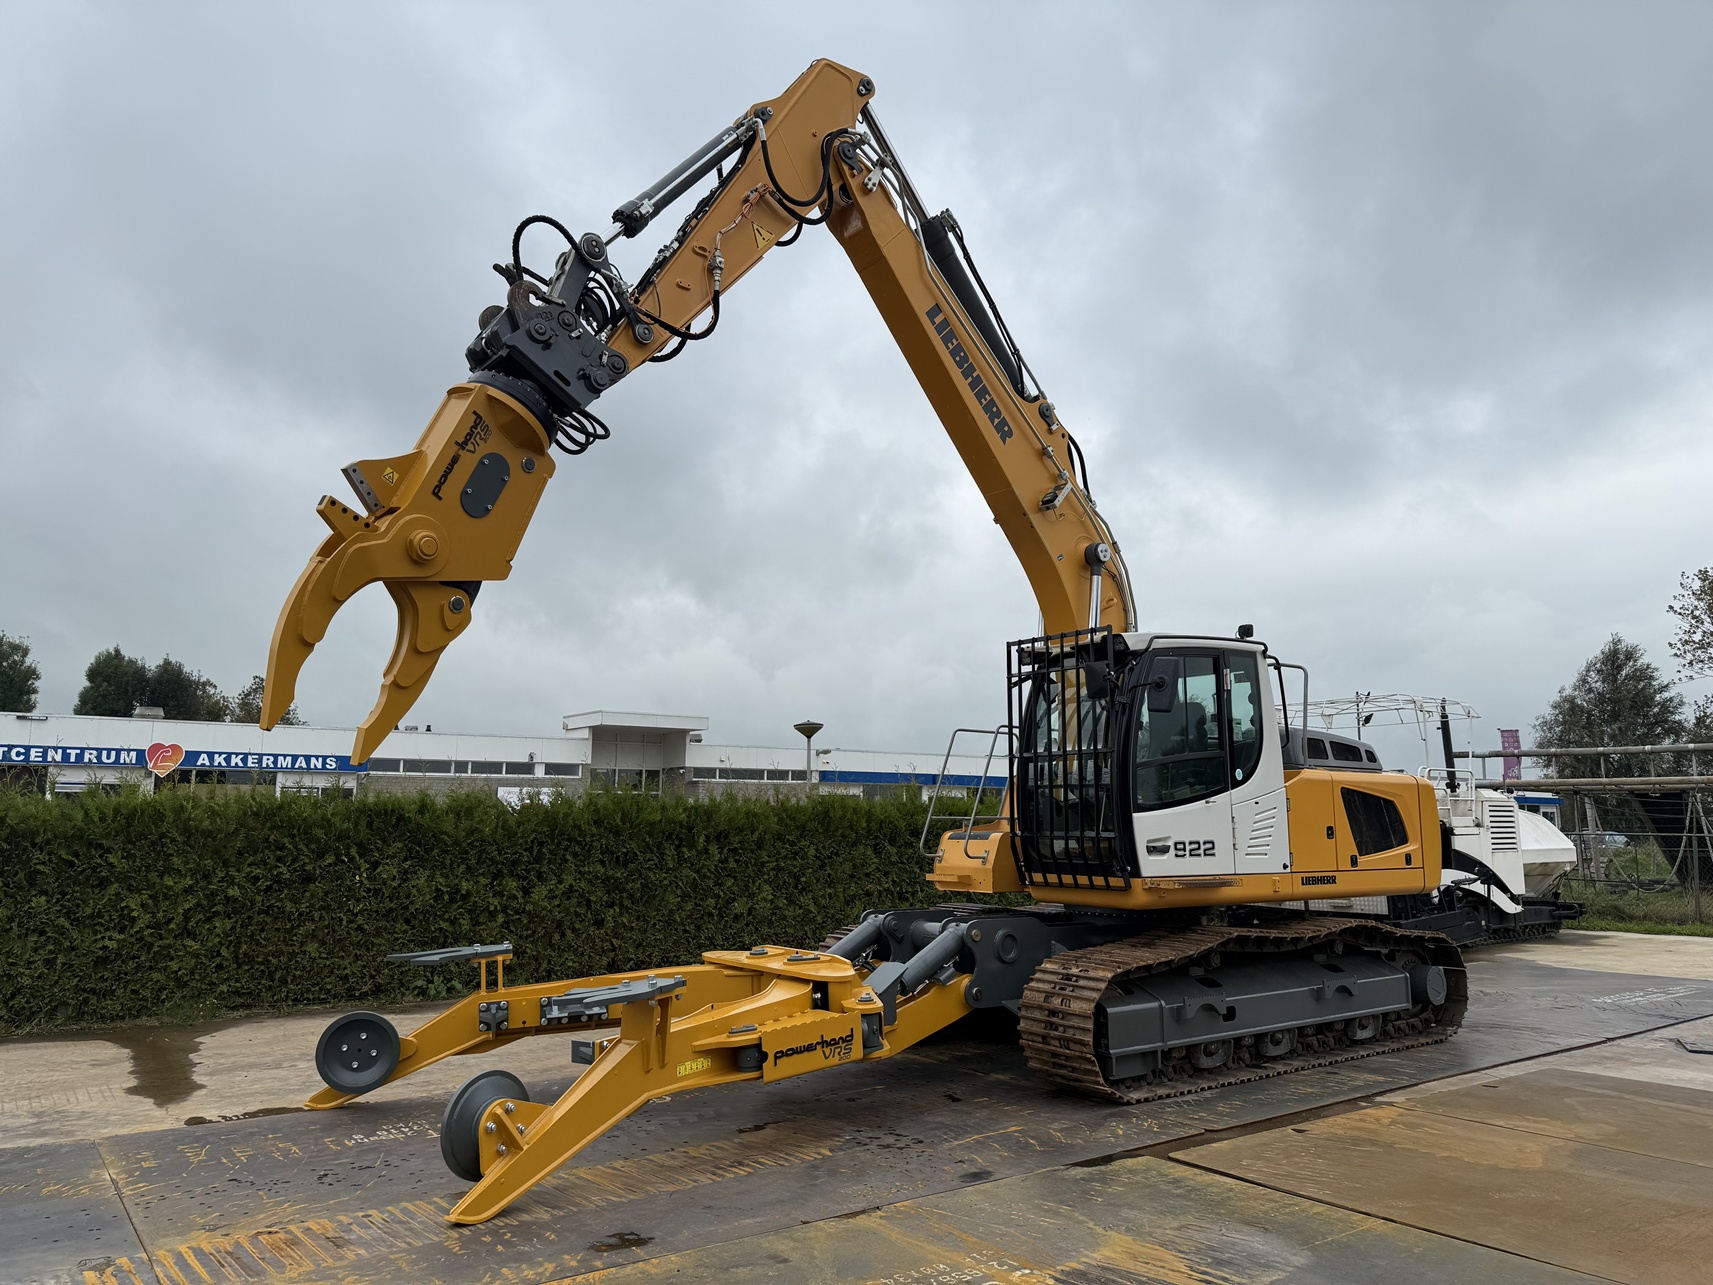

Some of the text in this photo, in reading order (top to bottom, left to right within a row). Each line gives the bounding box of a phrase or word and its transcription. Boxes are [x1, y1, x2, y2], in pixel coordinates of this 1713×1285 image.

[925, 303, 1013, 445] LIEBHERR
[466, 420, 489, 454] VRS
[431, 410, 483, 501] powerhand
[196, 753, 337, 770] AKKERMANS
[1173, 840, 1216, 857] 922
[1301, 875, 1337, 886] LIEBHERR
[774, 1027, 854, 1067] powerhand
[822, 1043, 853, 1060] VRS
